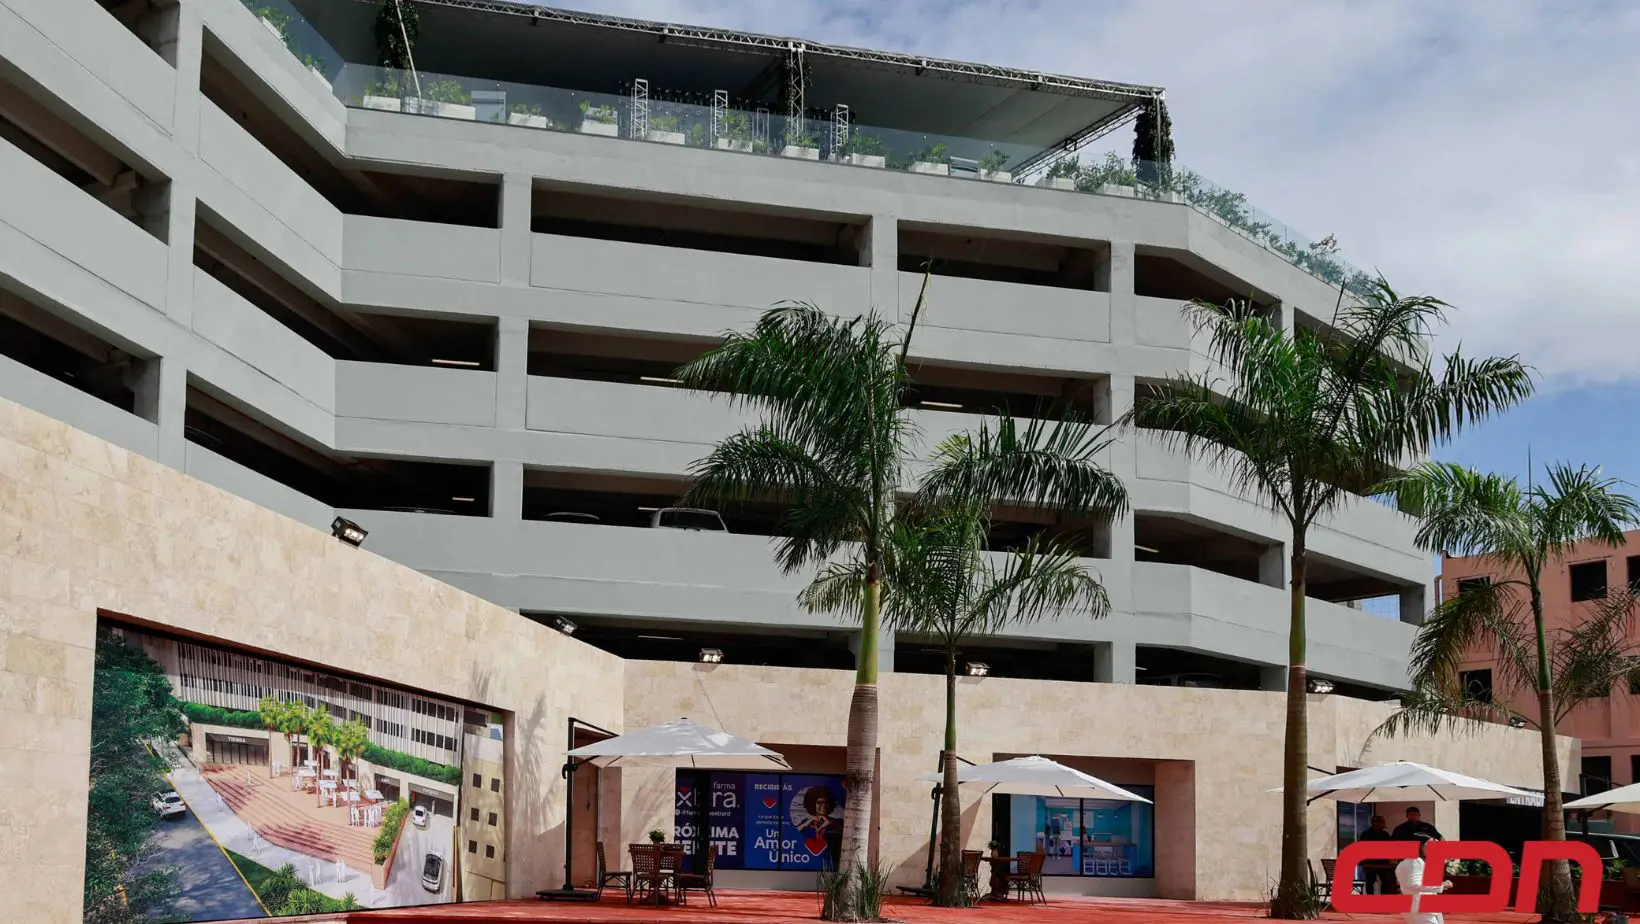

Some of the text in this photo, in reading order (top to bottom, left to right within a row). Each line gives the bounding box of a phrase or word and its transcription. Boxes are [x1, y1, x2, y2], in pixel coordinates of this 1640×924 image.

[713, 781, 736, 790] farma
[754, 837, 797, 849] Amor
[769, 848, 810, 864] Único
